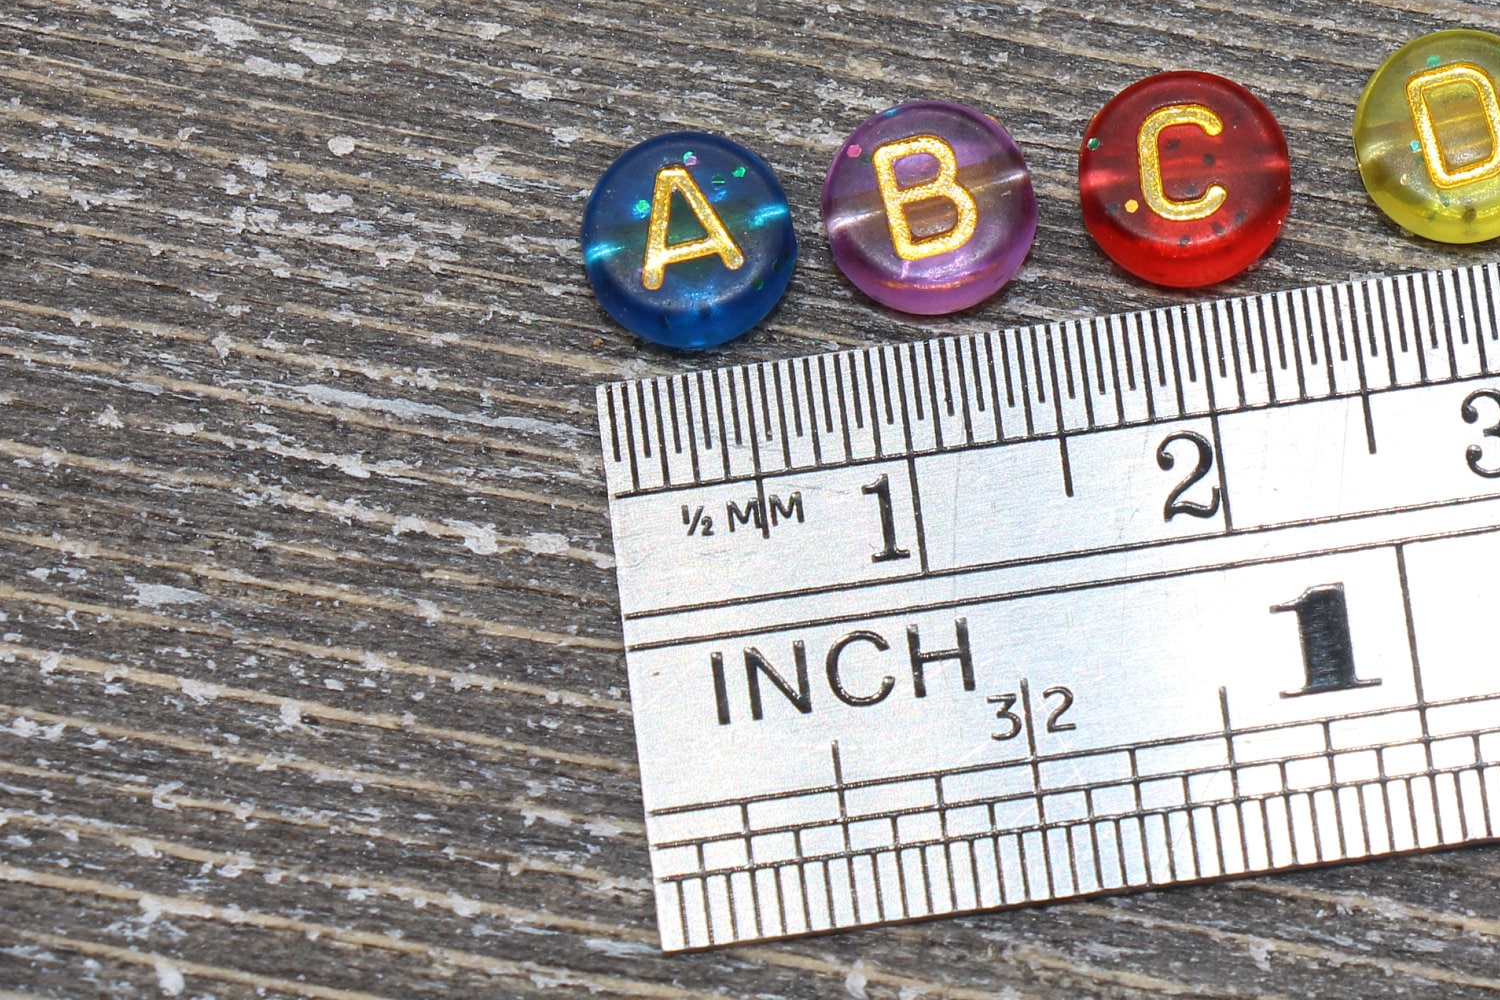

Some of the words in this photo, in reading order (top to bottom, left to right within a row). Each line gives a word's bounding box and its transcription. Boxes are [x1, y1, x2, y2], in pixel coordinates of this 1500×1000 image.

[642, 164, 745, 290] A
[872, 135, 977, 261] B
[1137, 103, 1227, 221] C
[861, 473, 910, 563] 1
[1155, 430, 1221, 522] 2
[709, 616, 976, 725] INCH
[1269, 581, 1382, 699] 1
